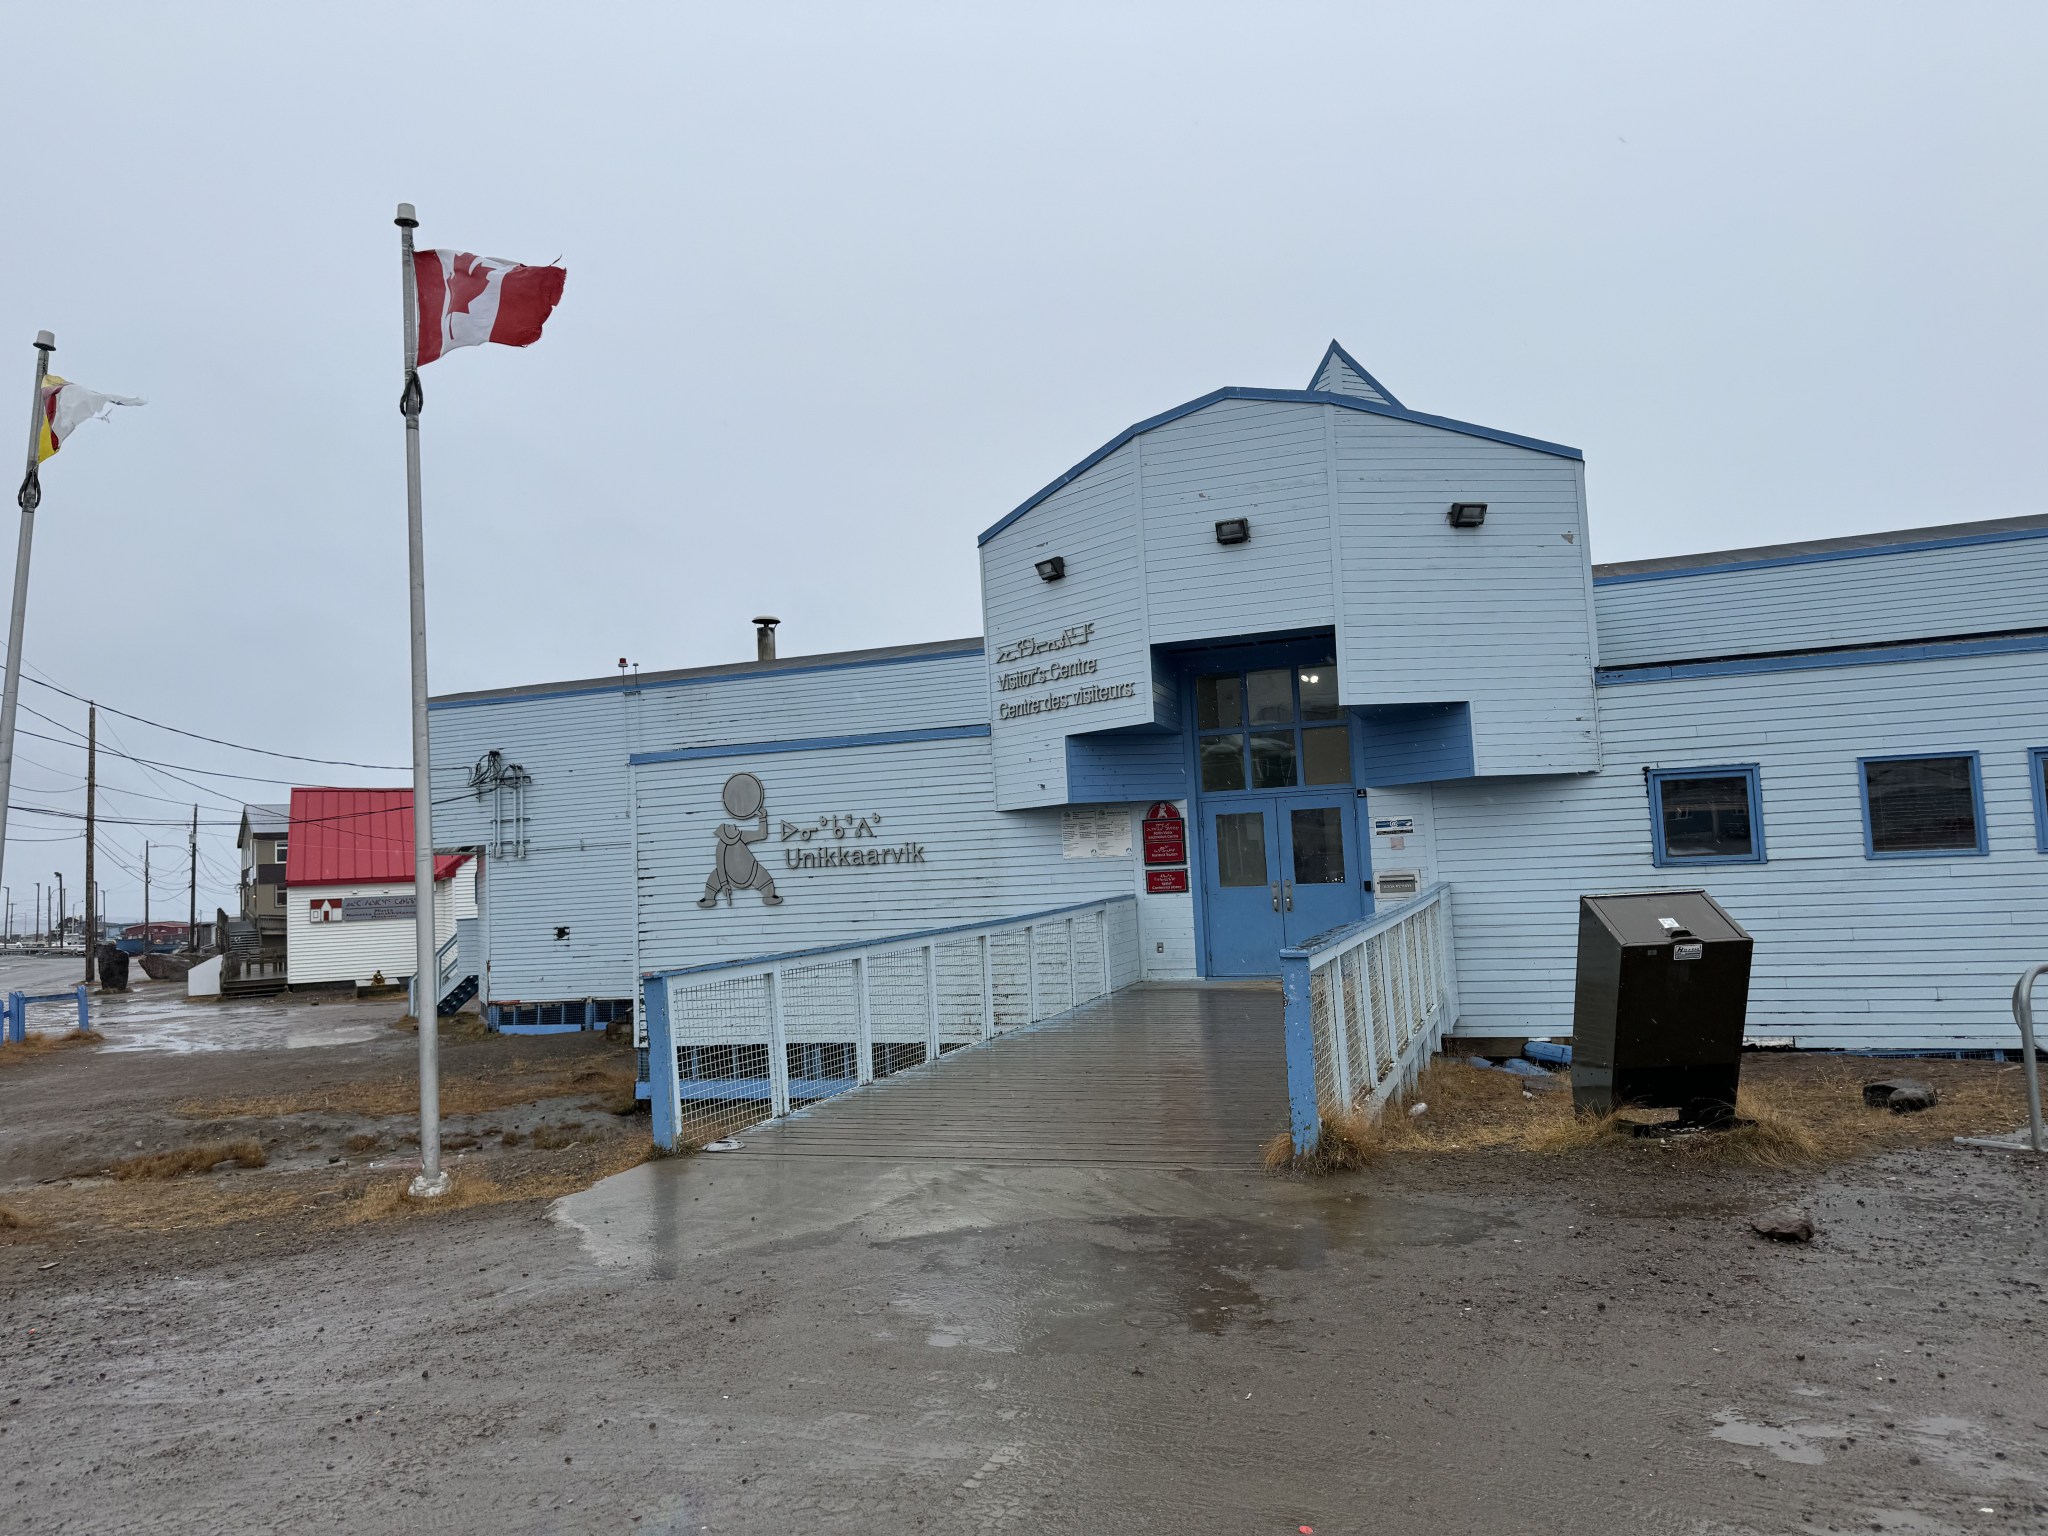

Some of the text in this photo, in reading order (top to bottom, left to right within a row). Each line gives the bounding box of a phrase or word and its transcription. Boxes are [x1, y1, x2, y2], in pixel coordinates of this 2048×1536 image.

[998, 658, 1098, 692] Visitor's Centre
[999, 682, 1136, 720] Centre des visiteurs
[785, 842, 925, 869] Unikkaarvik
